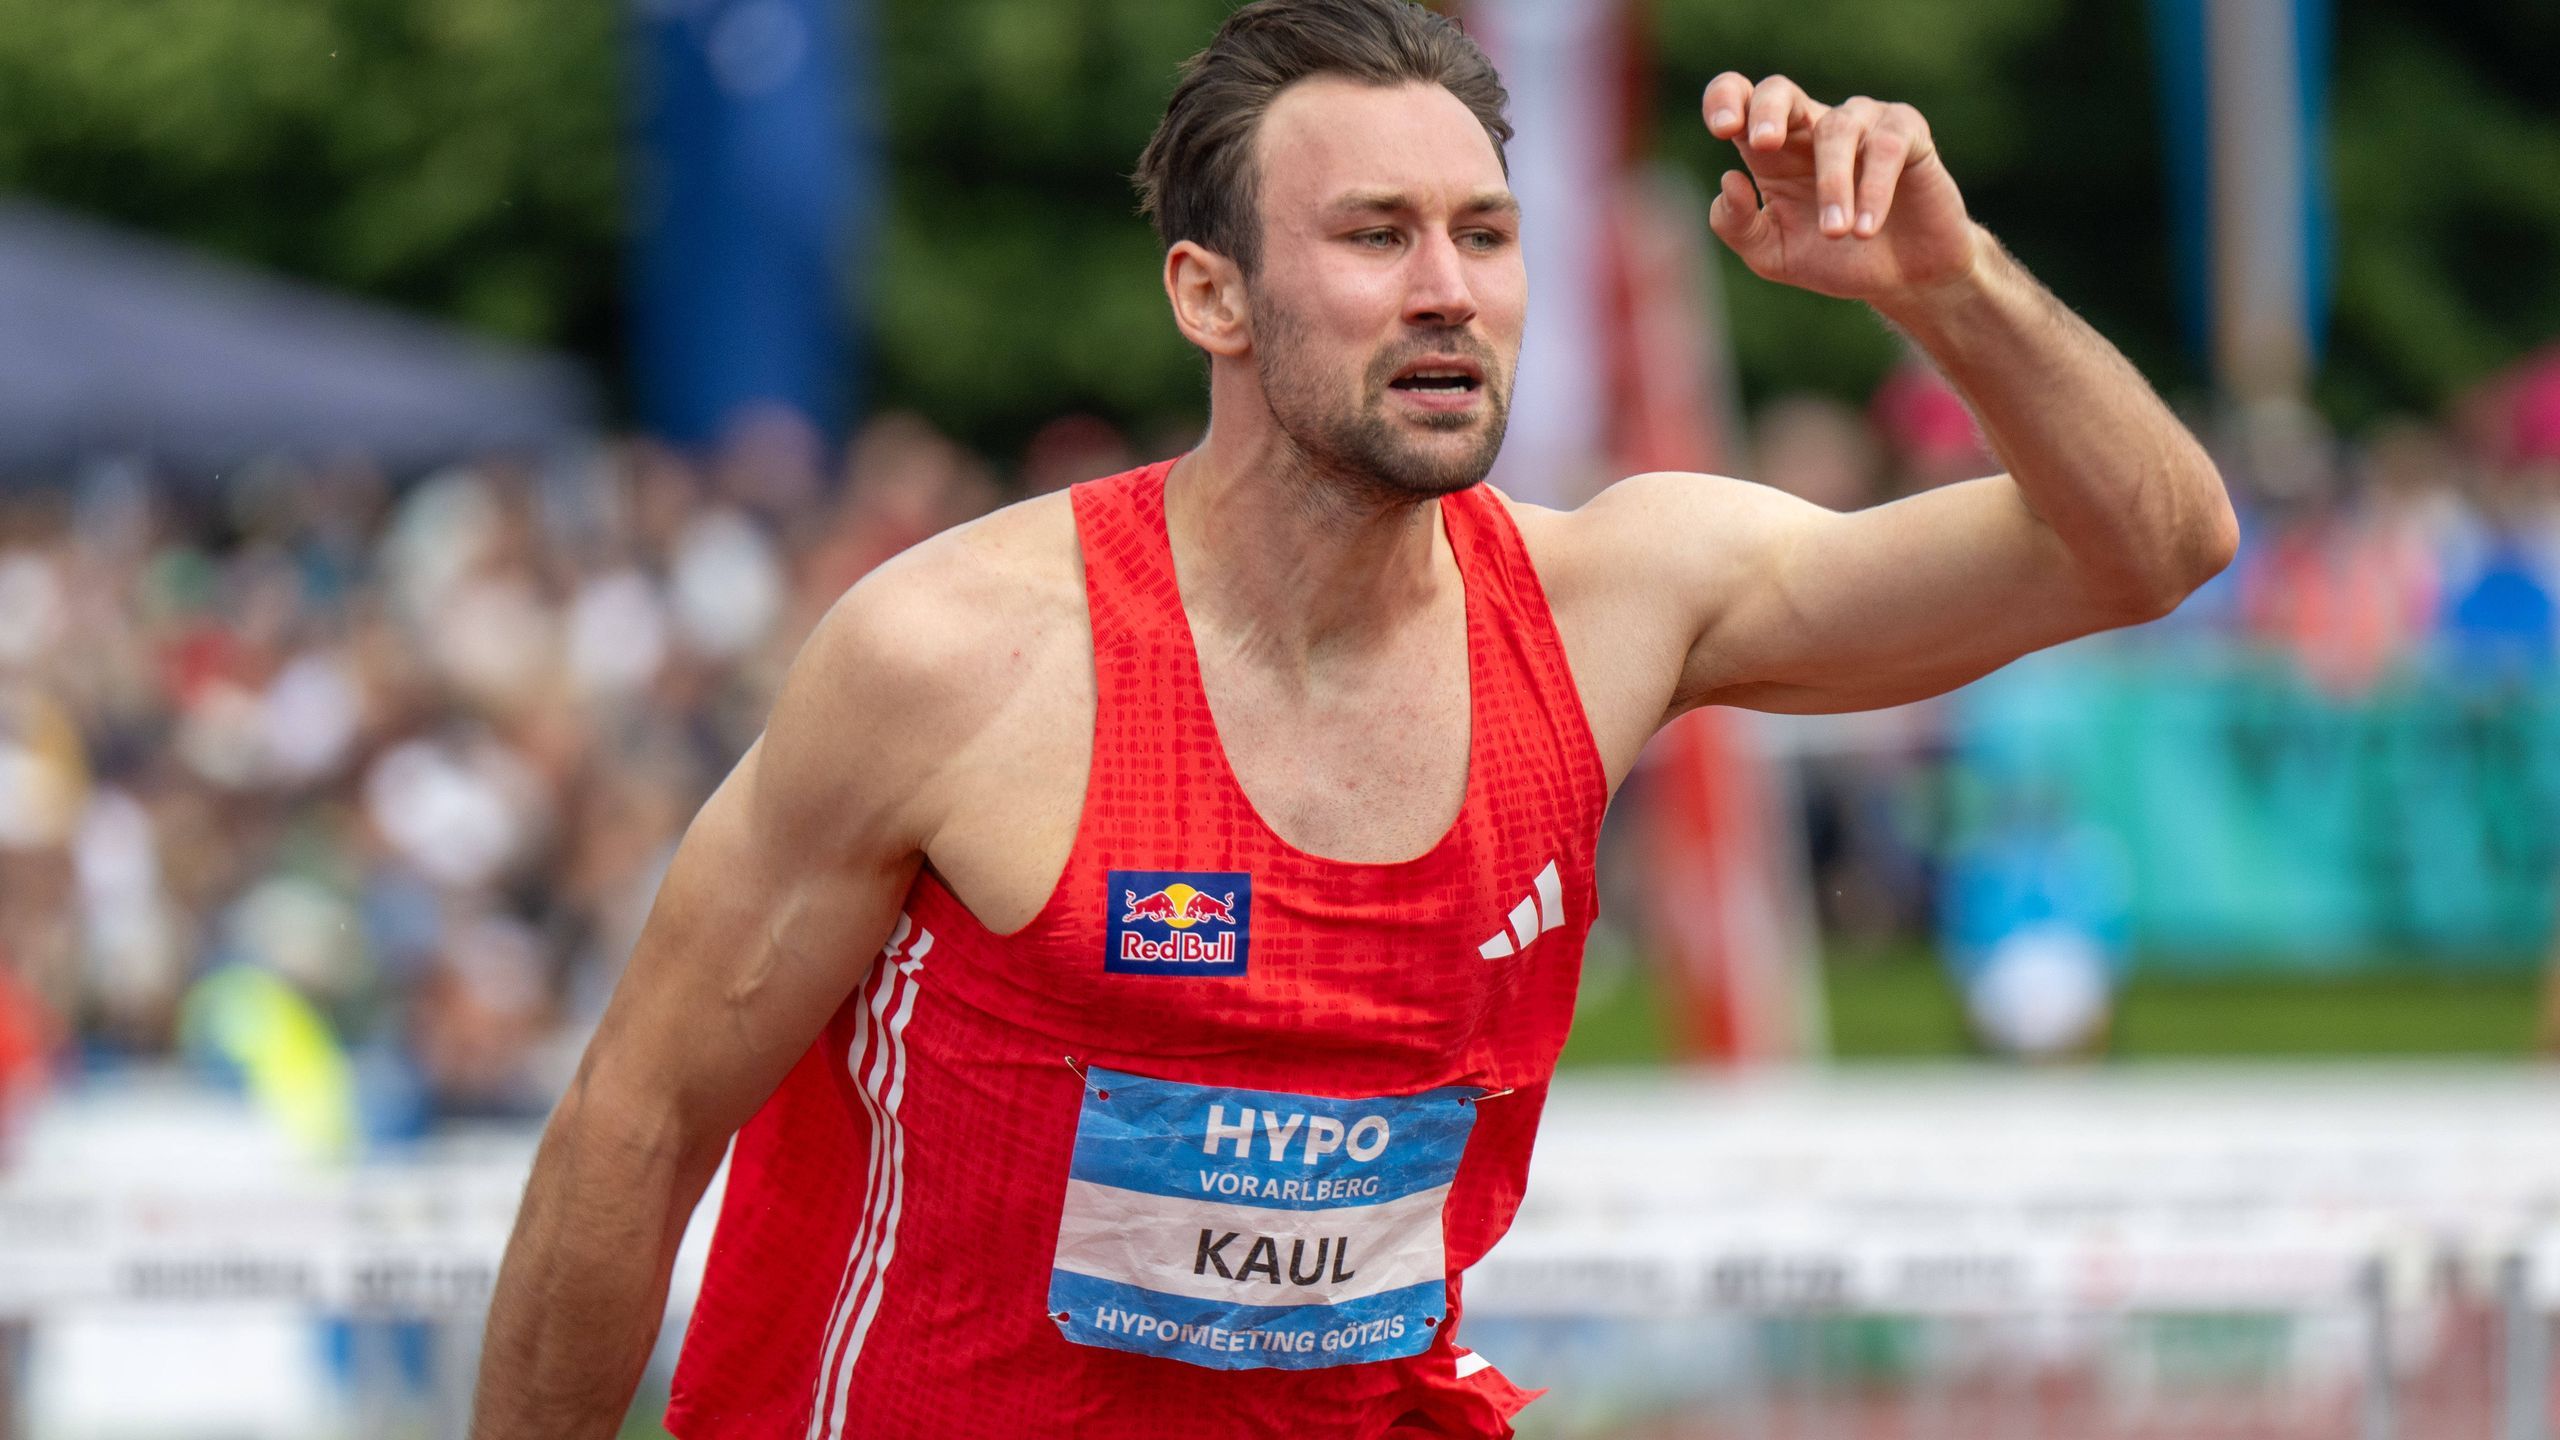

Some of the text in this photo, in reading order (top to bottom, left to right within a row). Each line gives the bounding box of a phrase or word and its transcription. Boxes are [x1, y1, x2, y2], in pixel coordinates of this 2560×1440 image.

[1121, 931, 1235, 962] Red Bull
[1203, 1105, 1390, 1165] HYPO
[1200, 1170, 1380, 1201] VORARLBERG
[1193, 1229, 1356, 1286] KAUL
[1095, 1306, 1405, 1353] HYPOMEETING GÖTZIS
